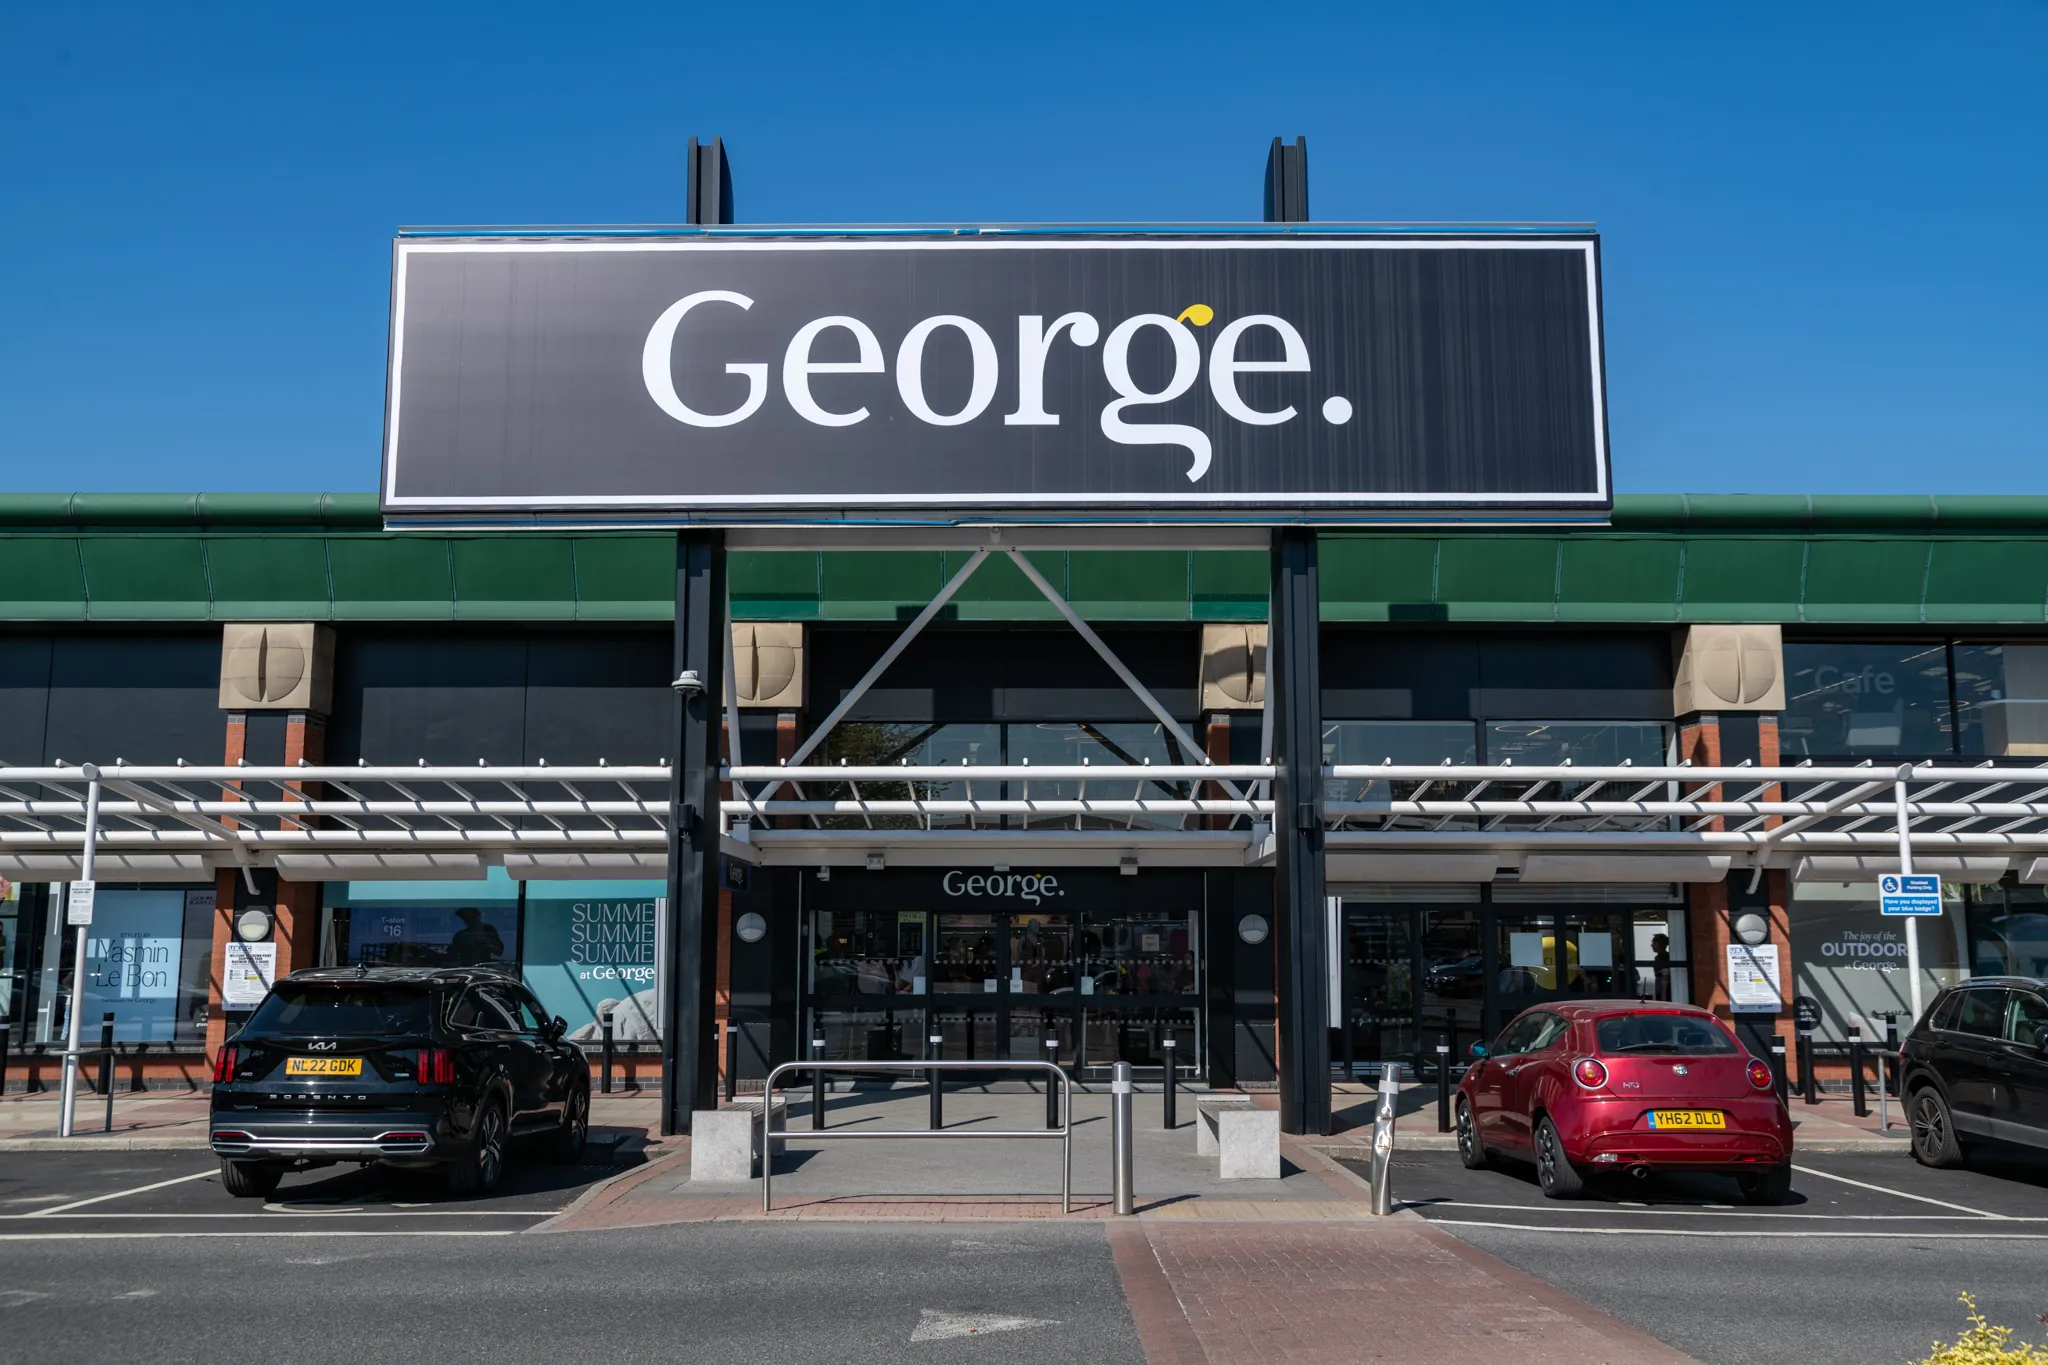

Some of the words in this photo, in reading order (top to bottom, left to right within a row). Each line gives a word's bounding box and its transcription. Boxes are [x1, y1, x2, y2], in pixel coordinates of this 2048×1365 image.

[642, 290, 1353, 483] George.
[1815, 665, 1895, 694] Cafe
[943, 870, 1065, 906] George.
[572, 903, 654, 923] SUMME
[383, 925, 402, 937] £16
[571, 923, 654, 943] SUMME
[1843, 931, 1859, 940] The
[1860, 931, 1872, 942] joy
[1873, 931, 1884, 942] of
[1883, 931, 1897, 940] the
[100, 939, 169, 963] Yasmin
[571, 943, 654, 963] SUMME
[1821, 942, 1911, 957] OUTDOOR
[96, 964, 120, 987] Le
[126, 964, 167, 987] Bon
[1852, 960, 1900, 974] George.
[580, 972, 591, 980] at
[308, 1042, 337, 1050] KIA
[291, 1060, 326, 1072] NL22
[330, 1060, 356, 1072] GDK
[1656, 1112, 1692, 1125] YH62
[1694, 1112, 1721, 1125] DLO
